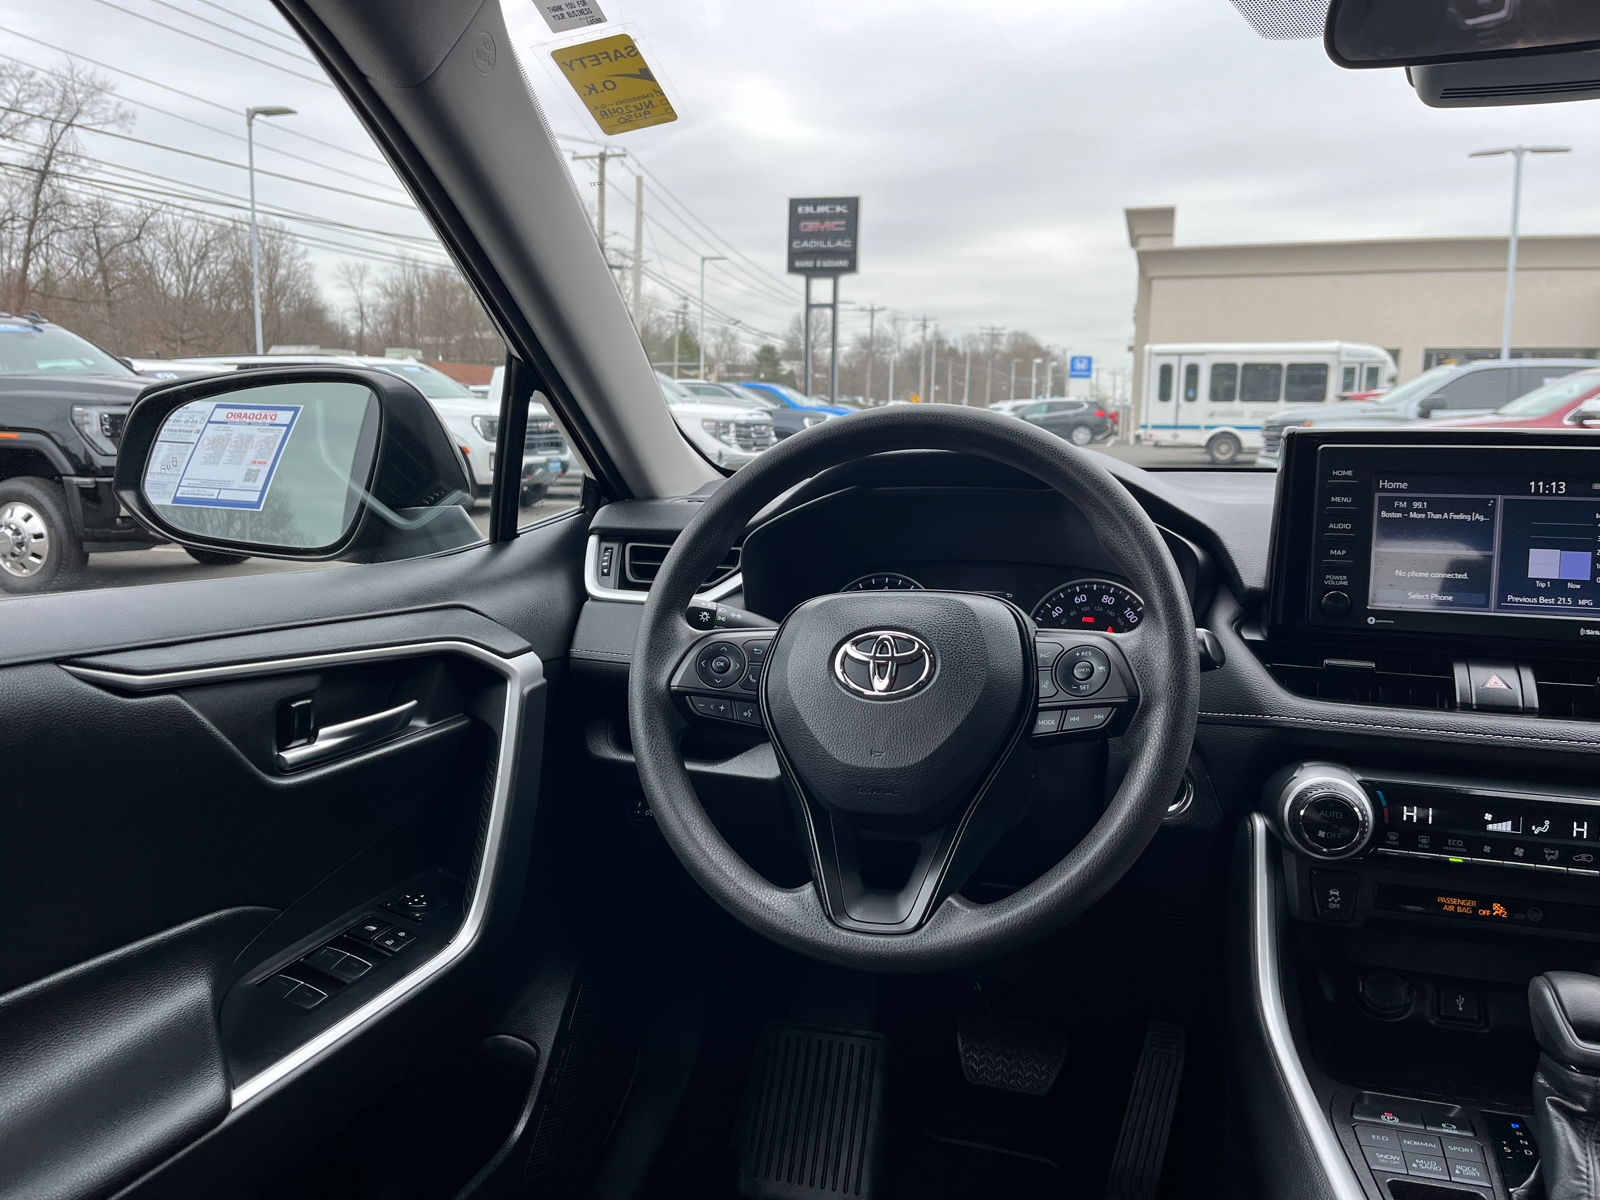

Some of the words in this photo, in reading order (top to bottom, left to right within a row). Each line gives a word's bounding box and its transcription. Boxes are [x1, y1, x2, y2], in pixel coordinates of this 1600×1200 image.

[547, 5, 564, 13] THANK
[552, 13, 567, 21] YOUR
[566, 7, 593, 18] BUSINESS
[797, 205, 849, 214] BUICK
[800, 221, 846, 232] GMC
[792, 240, 852, 248] CADILLAC
[1379, 479, 1408, 489] Home
[1529, 481, 1567, 494] 11:13
[1412, 501, 1427, 509] 99.1
[1409, 511, 1426, 519] More
[1426, 511, 1442, 519] Than
[1449, 512, 1471, 521] Feeling
[1395, 569, 1406, 577] No
[1407, 570, 1429, 579] phone
[1074, 594, 1087, 604] 60
[1101, 594, 1115, 605] 80
[1408, 592, 1429, 600] Select
[1430, 593, 1453, 601] Phone
[1507, 594, 1538, 604] Previous
[1539, 596, 1555, 604] Best
[1557, 597, 1572, 605] 21.5
[1051, 606, 1063, 618] 40
[1069, 609, 1077, 617] 80
[1123, 607, 1138, 624] 100
[1319, 810, 1343, 819] AUTO
[1326, 831, 1342, 839] OFF
[1447, 839, 1463, 847] ECO
[1437, 896, 1477, 907] PASSENGER
[1442, 904, 1455, 912] AIR
[1456, 906, 1473, 914] BAG
[1403, 1139, 1437, 1149] NORMAL
[1448, 1145, 1473, 1153] SPORT
[1375, 1152, 1400, 1161] SNOW
[1419, 1163, 1442, 1172] SAND
[1455, 1164, 1477, 1172] ROCK
